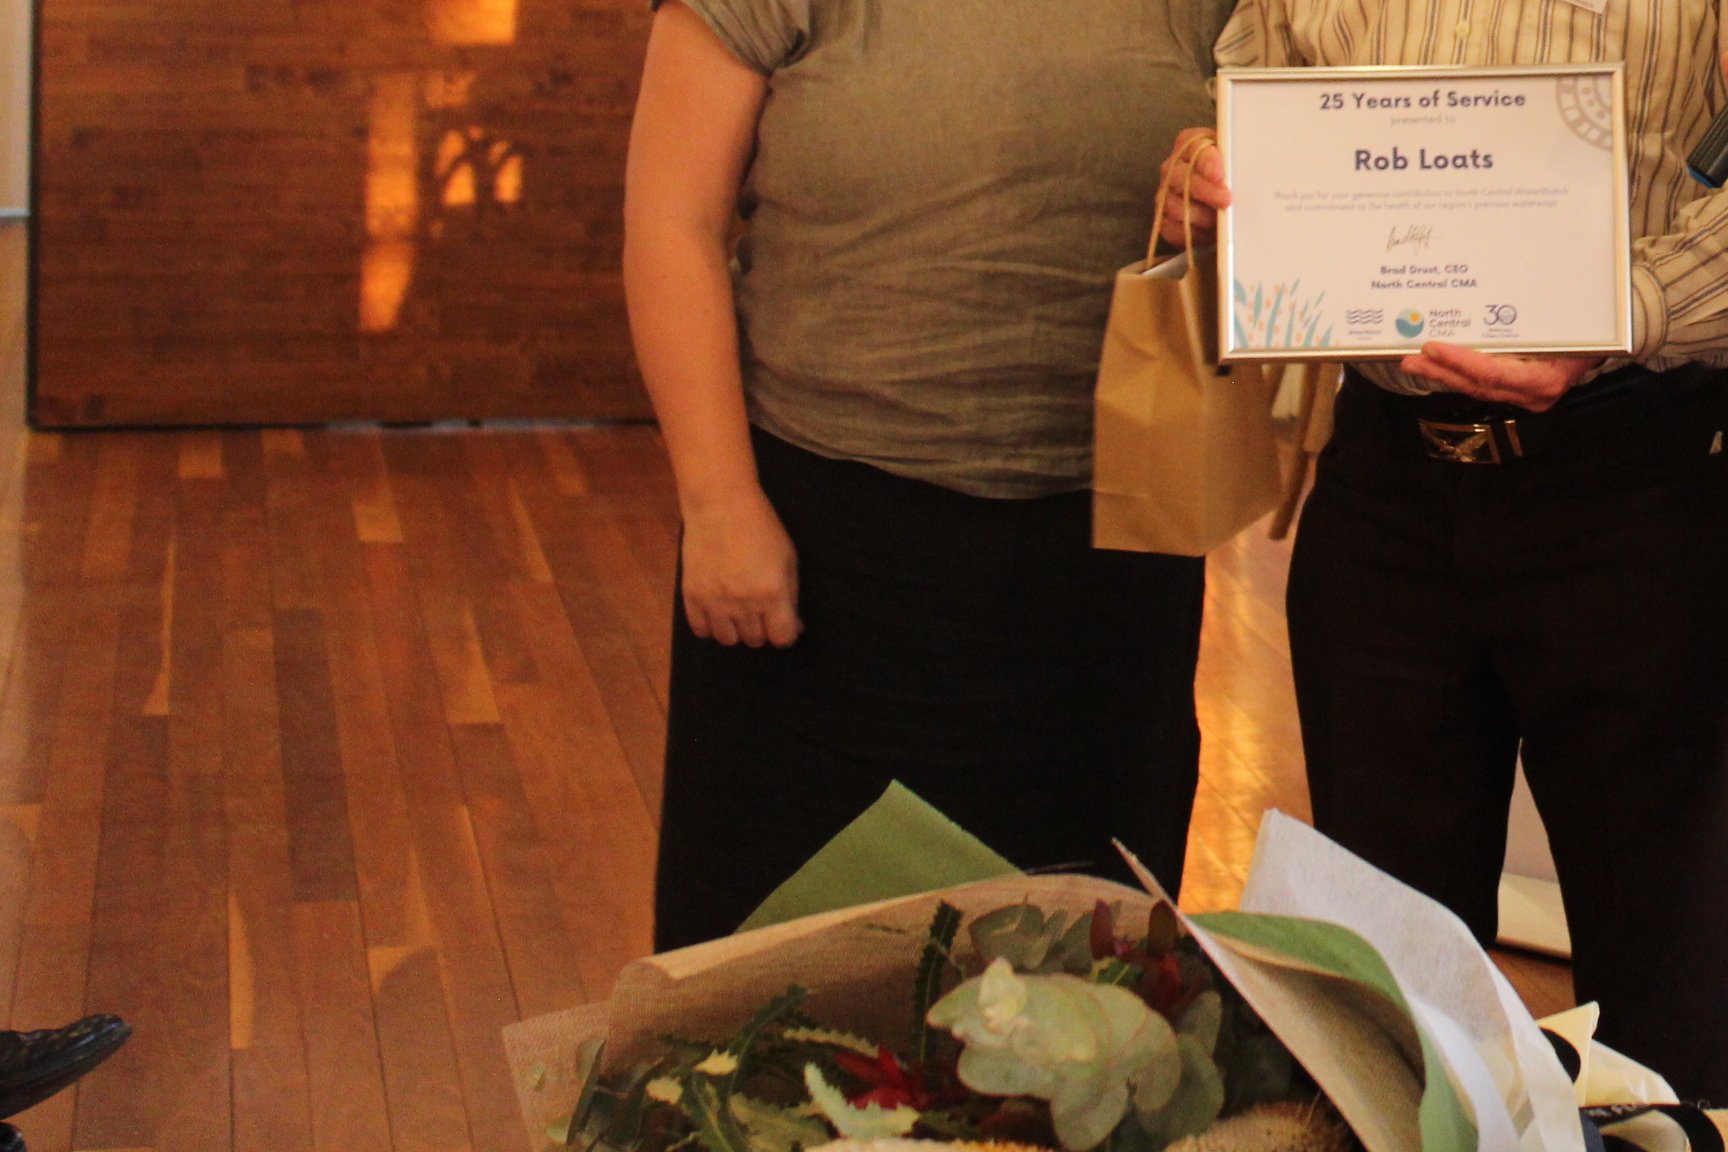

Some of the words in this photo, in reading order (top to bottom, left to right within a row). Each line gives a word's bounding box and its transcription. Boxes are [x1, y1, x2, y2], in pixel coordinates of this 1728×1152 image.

[1320, 93, 1344, 110] 25
[1352, 92, 1412, 109] Years
[1418, 90, 1440, 108] of
[1447, 90, 1526, 107] Service
[1390, 115, 1442, 126] presented
[1355, 147, 1408, 171] Rob
[1419, 148, 1494, 170] Loats
[1380, 265, 1406, 275] Brad
[1445, 264, 1469, 274] CEO
[1371, 280, 1402, 289] North
[1407, 279, 1448, 289] Central
[1451, 279, 1478, 288] CMA
[1429, 309, 1462, 318] North
[1482, 304, 1518, 326] 30
[1429, 318, 1471, 328] Central
